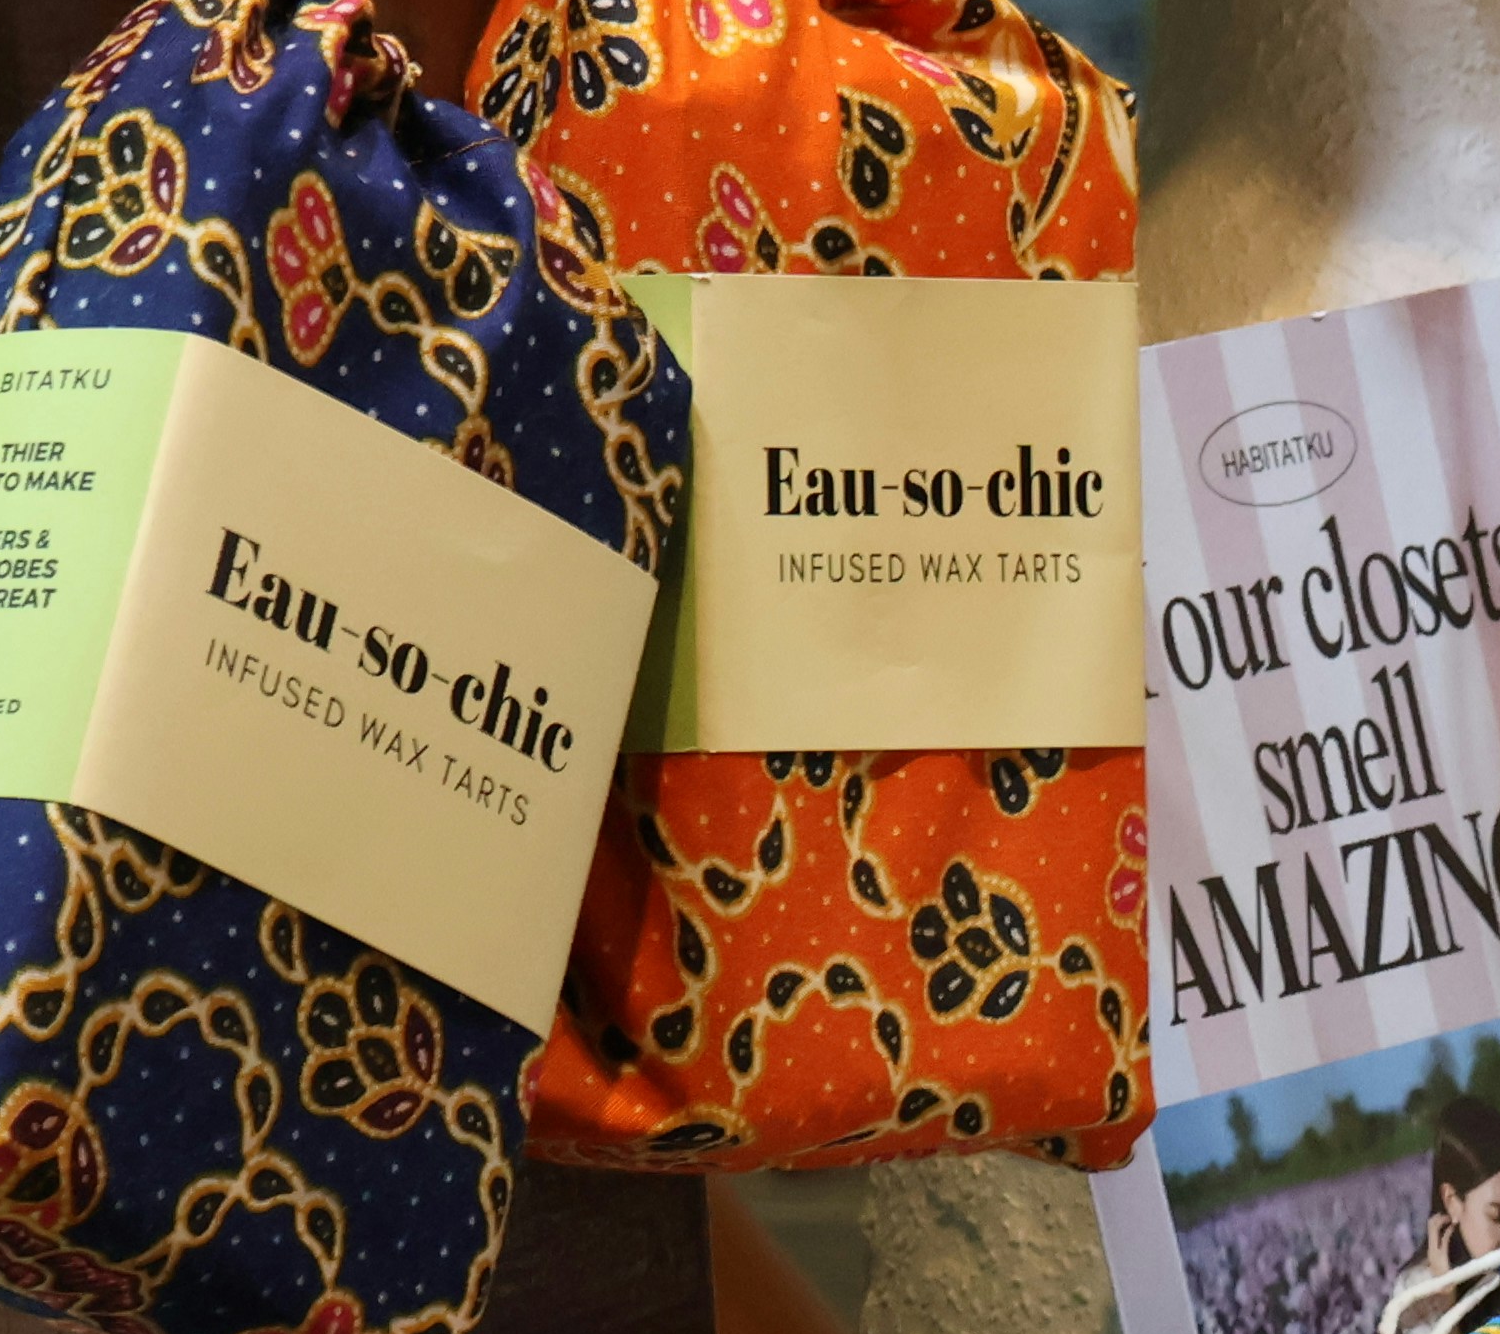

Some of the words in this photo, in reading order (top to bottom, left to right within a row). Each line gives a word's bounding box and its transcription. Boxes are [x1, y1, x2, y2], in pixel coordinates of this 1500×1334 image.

[24, 471, 96, 492] MAKE
[762, 444, 1104, 518] Eau-so-chic
[1221, 431, 1334, 478] HABITATKU
[35, 529, 51, 549] &
[778, 552, 905, 583] INFUSED
[919, 552, 983, 583] WAX
[997, 552, 1082, 583] TARTS
[205, 526, 573, 773] Eau-so-chic
[1144, 572, 1291, 700] our
[205, 638, 346, 728] INFUSED
[360, 712, 430, 773] WAX
[441, 754, 531, 826] TARTS
[1254, 661, 1444, 835] smell
